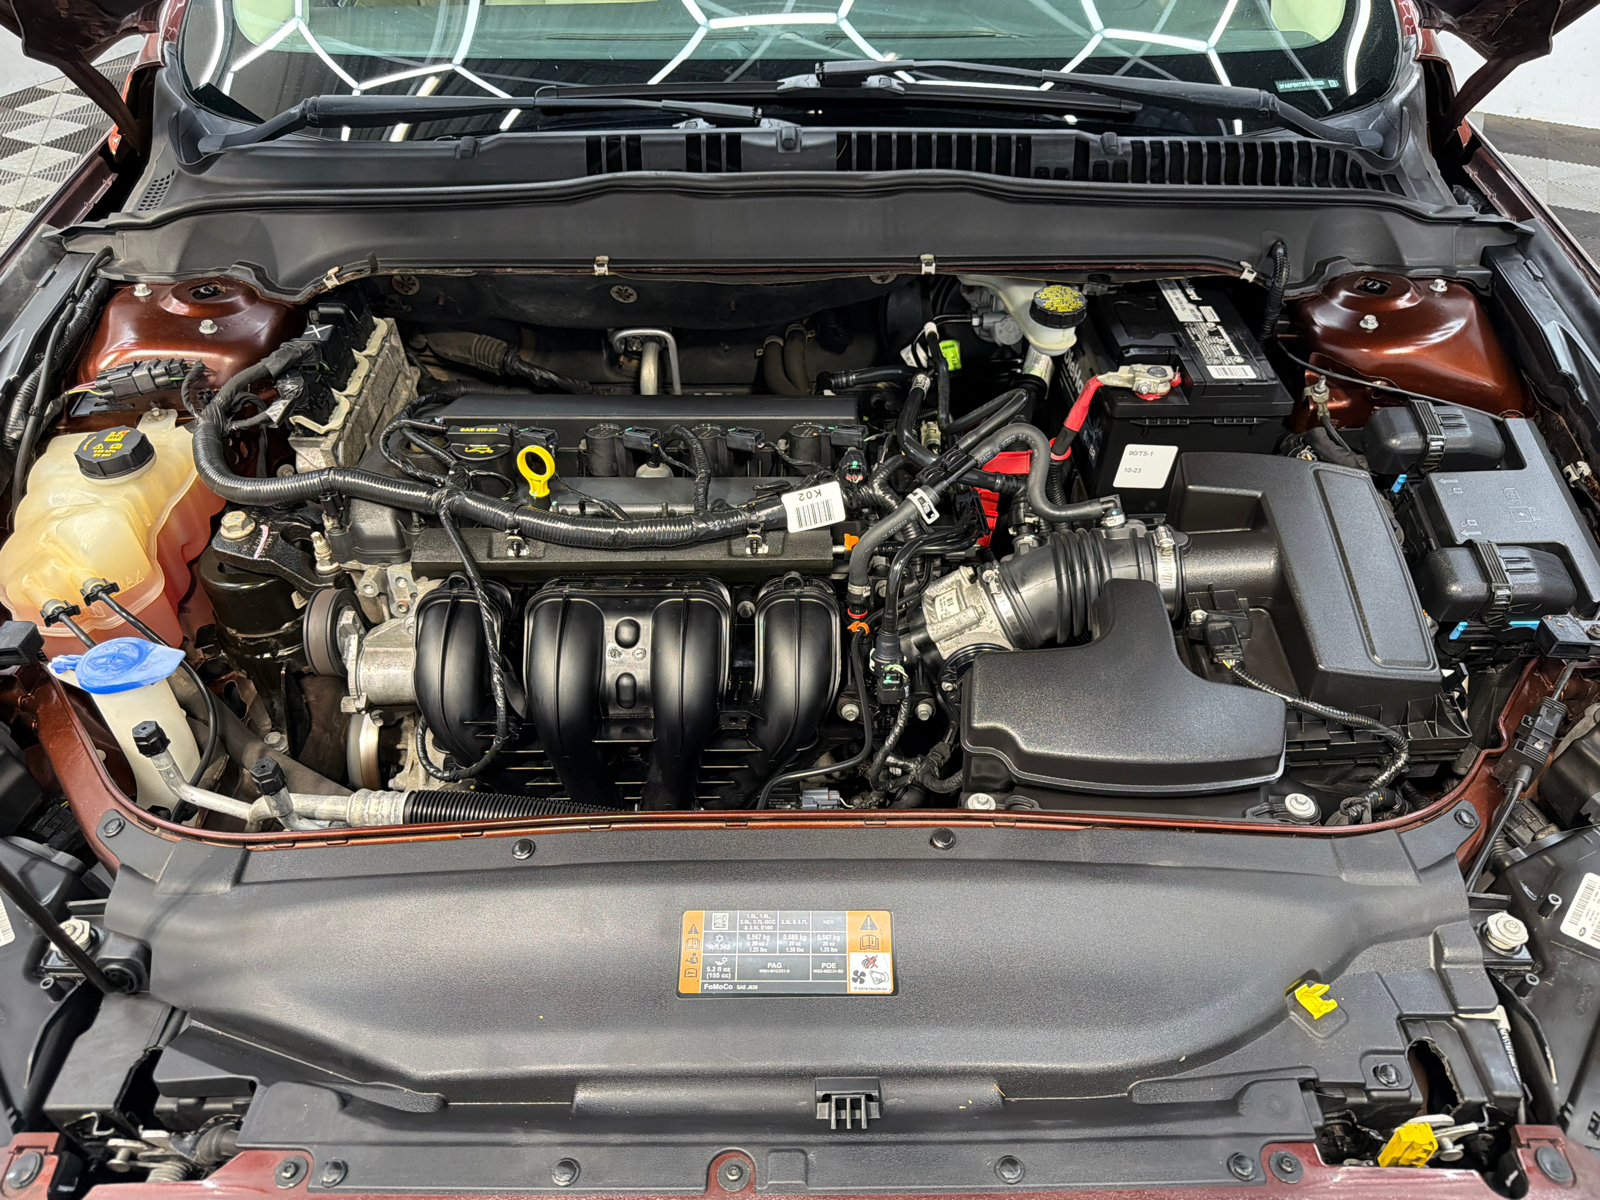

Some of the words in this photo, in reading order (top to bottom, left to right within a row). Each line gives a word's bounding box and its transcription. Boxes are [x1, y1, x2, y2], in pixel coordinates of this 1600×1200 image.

[797, 488, 822, 502] K02
[762, 933, 771, 942] kg
[799, 933, 807, 942] kg
[832, 933, 841, 942] kg
[706, 972, 720, 980] (155
[721, 972, 732, 980] cc)
